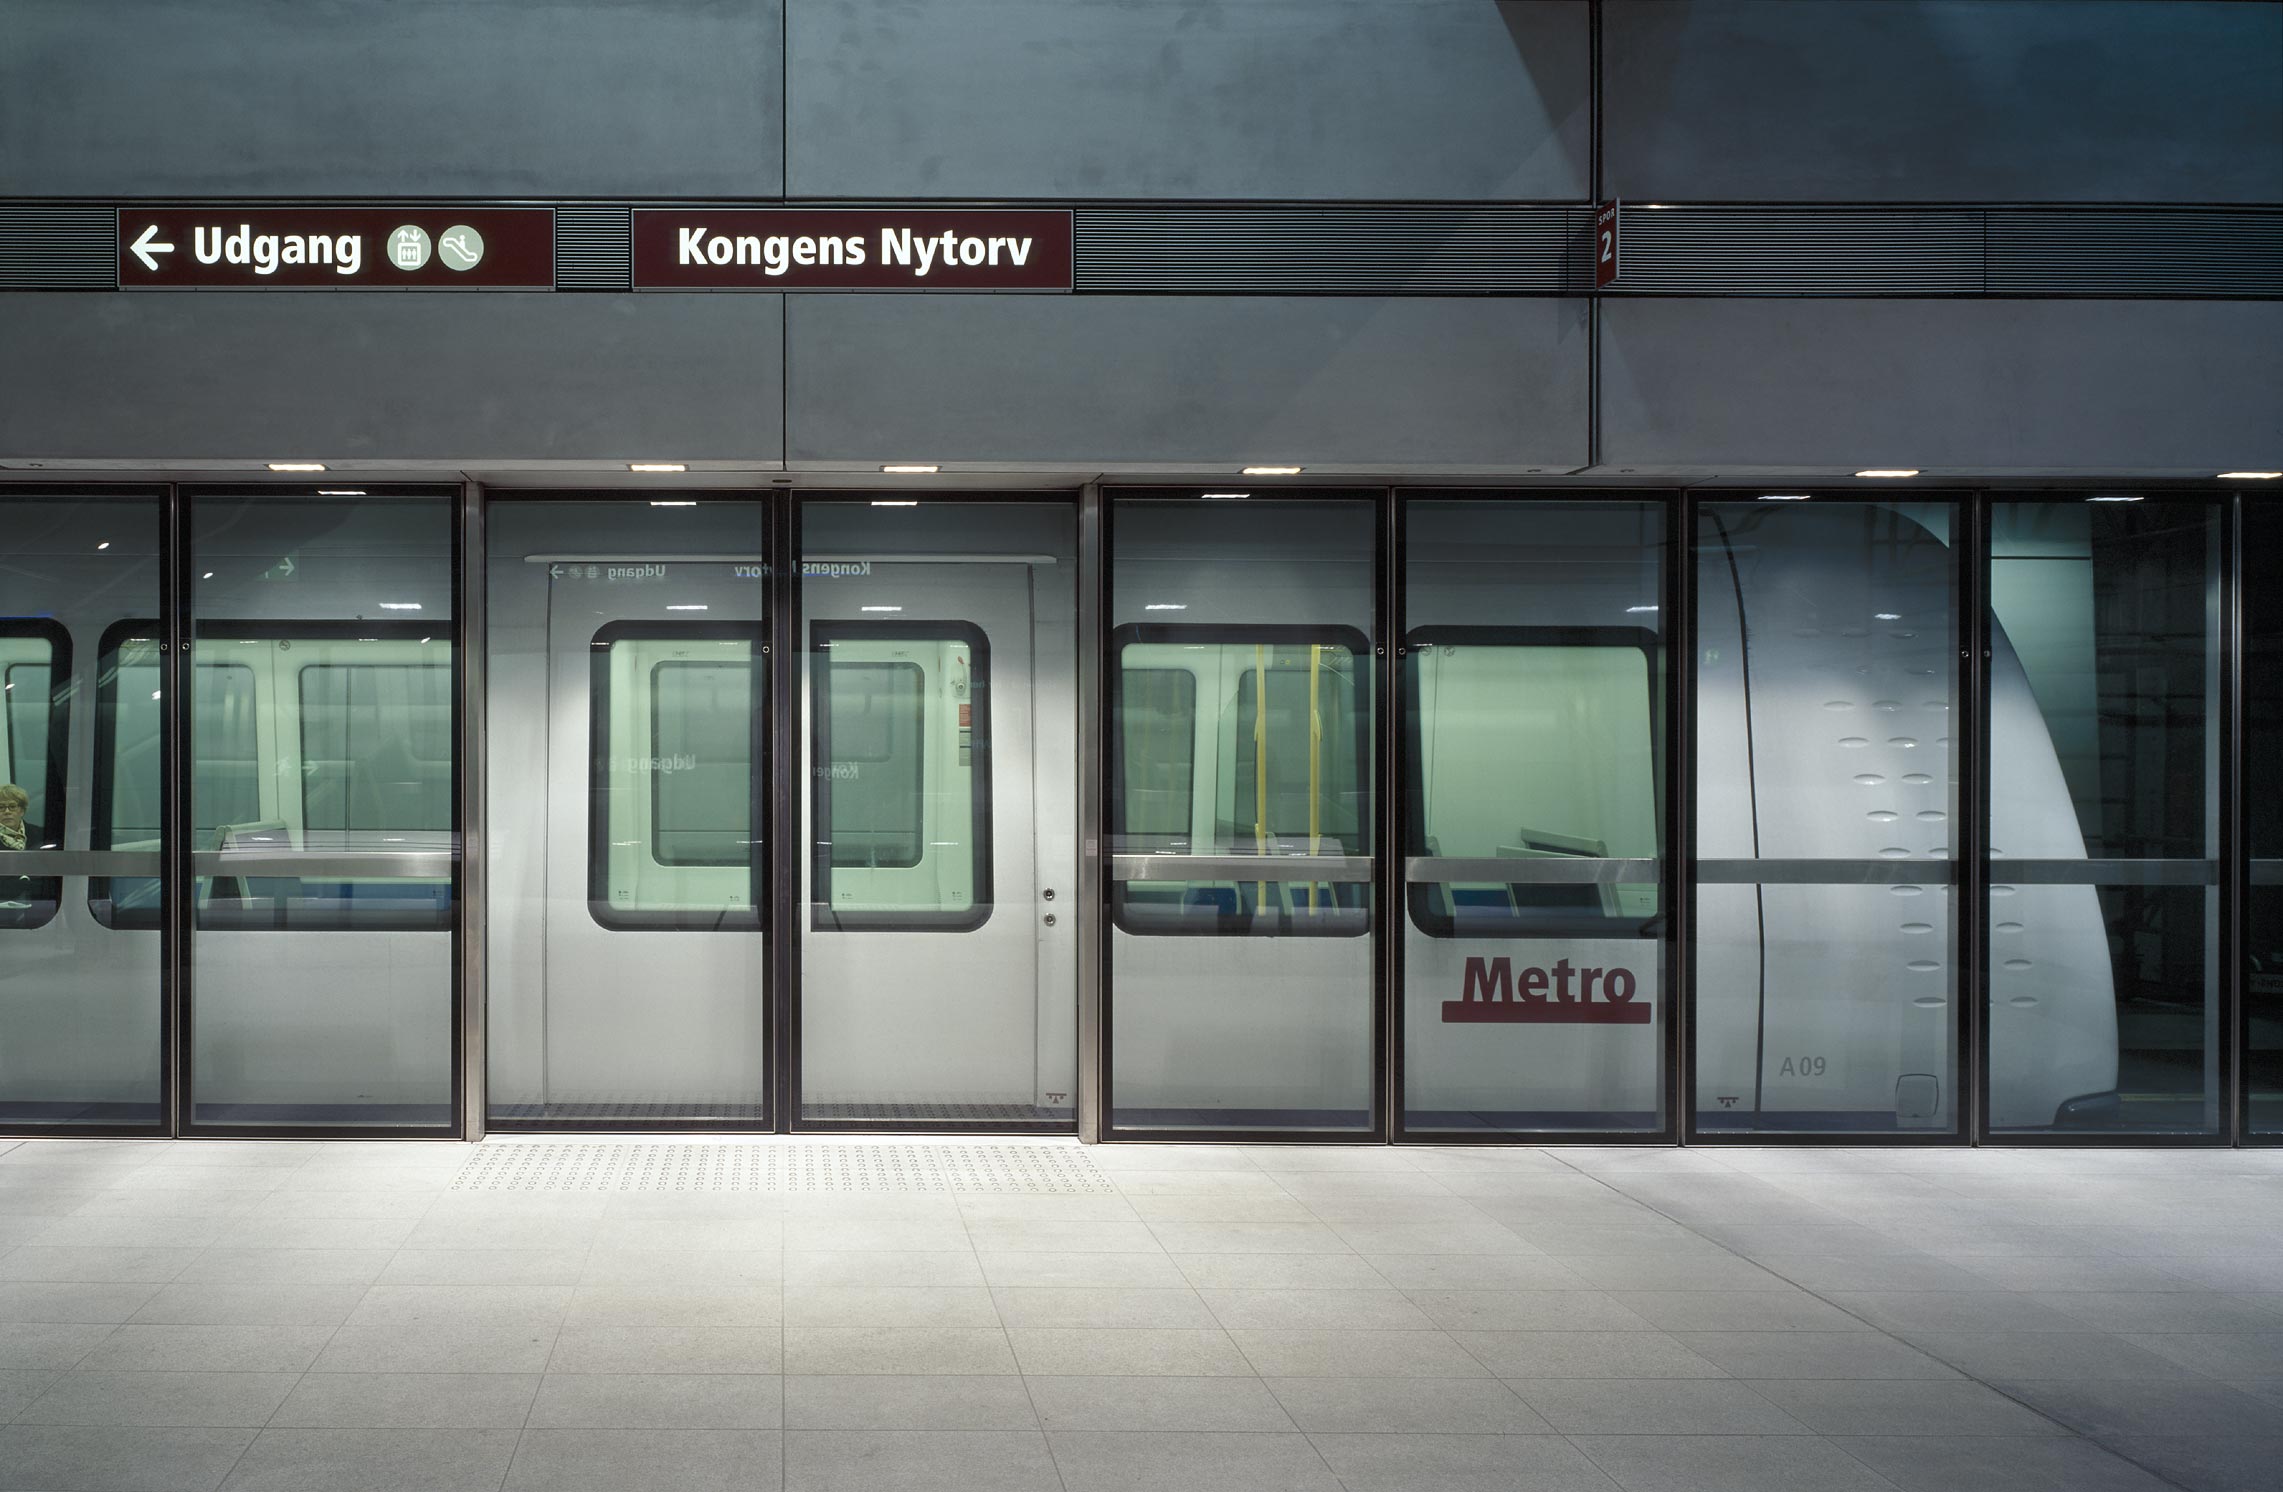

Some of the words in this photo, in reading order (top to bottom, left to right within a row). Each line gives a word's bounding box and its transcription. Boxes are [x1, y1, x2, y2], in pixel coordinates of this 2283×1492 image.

[1598, 207, 1615, 226] SPOR
[194, 224, 362, 275] Udgang
[679, 227, 866, 276] Kongens
[881, 227, 1033, 277] Nytorv
[1601, 230, 1612, 263] 2
[1462, 956, 1637, 1004] Metro
